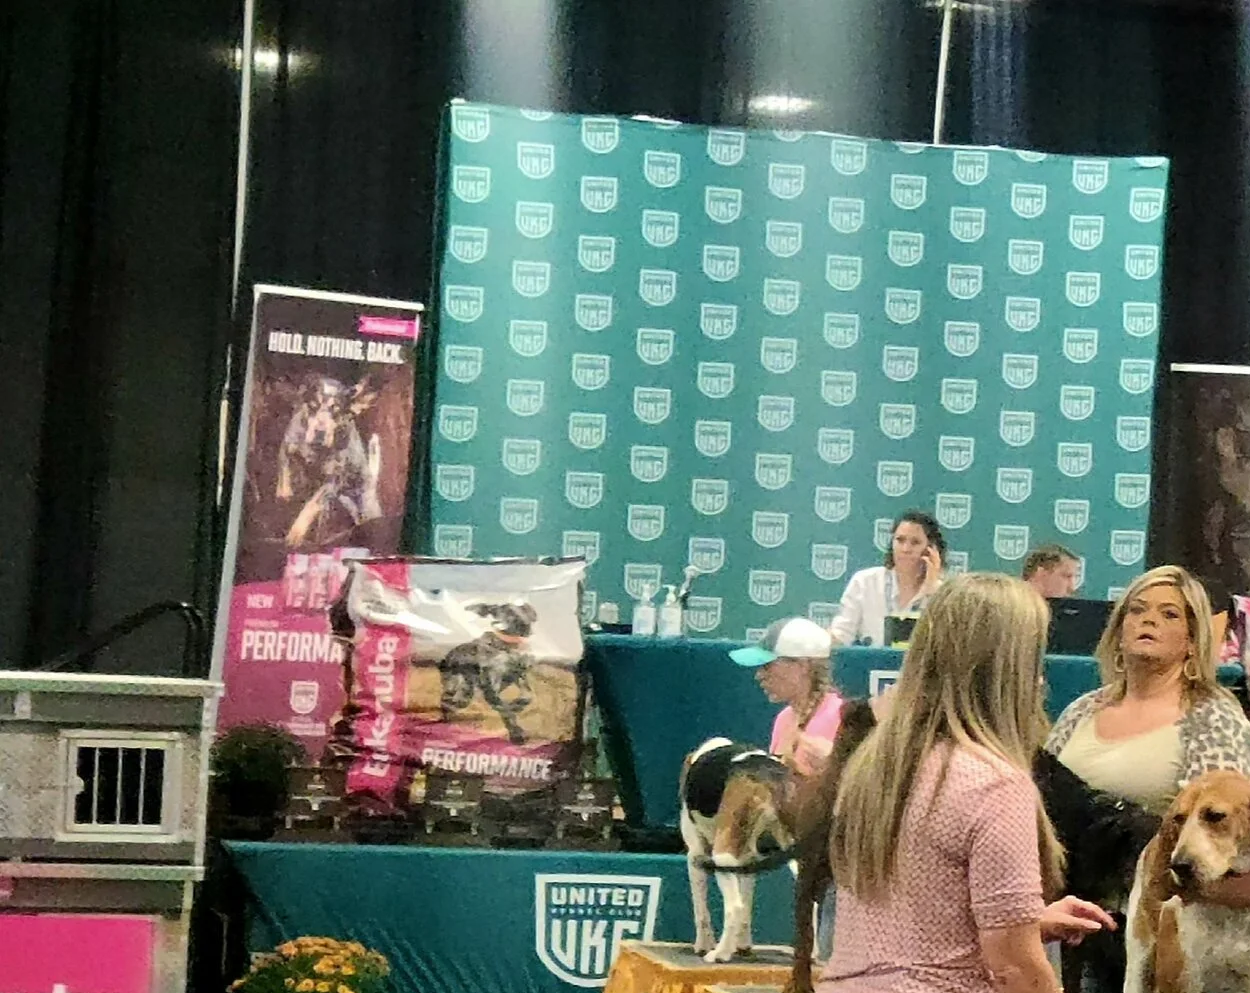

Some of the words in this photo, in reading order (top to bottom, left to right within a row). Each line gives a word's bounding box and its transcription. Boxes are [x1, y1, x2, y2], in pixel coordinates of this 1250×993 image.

[458, 120, 485, 137] UKC
[587, 131, 615, 149] UKC
[712, 143, 740, 161] UKC
[522, 156, 549, 174] UKC
[836, 153, 863, 171] UKC
[649, 164, 676, 183] UKC
[957, 164, 983, 181] UKC
[1077, 172, 1105, 189] UKC
[458, 179, 486, 198] UKC
[773, 177, 800, 195] UKC
[585, 190, 613, 208] UKC
[895, 187, 922, 205] UKC
[1016, 196, 1042, 214] UKC
[710, 200, 737, 219] UKC
[1134, 201, 1160, 218] UKC
[521, 215, 549, 233] UKC
[833, 211, 859, 229] UKC
[954, 220, 981, 238] UKC
[647, 224, 674, 242] UKC
[1074, 228, 1099, 246] UKC
[455, 240, 483, 258] UKC
[771, 234, 797, 253] UKC
[583, 249, 611, 267] UKC
[892, 244, 919, 262] UKC
[1013, 253, 1039, 270] UKC
[708, 259, 735, 277] UKC
[1129, 258, 1154, 275] UKC
[517, 274, 545, 293] UKC
[831, 268, 857, 286] UKC
[952, 277, 978, 295] UKC
[644, 283, 672, 301] UKC
[768, 292, 796, 310] UKC
[1070, 285, 1096, 302] UKC
[450, 299, 478, 318] UKC
[580, 308, 607, 327] UKC
[890, 302, 917, 320] UKC
[705, 317, 732, 335] UKC
[1010, 310, 1036, 327] UKC
[1127, 315, 1152, 332] UKC
[514, 334, 542, 352] UKC
[828, 326, 855, 344] UKC
[949, 335, 975, 352] UKC
[306, 335, 364, 359] NOTHING.
[642, 342, 670, 360] UKC
[1068, 342, 1093, 359] UKC
[450, 359, 478, 378] UKC
[766, 351, 792, 369] UKC
[887, 359, 914, 377] UKC
[577, 367, 605, 385] UKC
[1007, 367, 1033, 384] UKC
[1124, 372, 1149, 389] UKC
[702, 376, 730, 394] UKC
[826, 384, 852, 402] UKC
[512, 393, 539, 411] UKC
[946, 392, 973, 409] UKC
[1065, 398, 1090, 416] UKC
[639, 401, 666, 419] UKC
[762, 409, 790, 427] UKC
[444, 419, 472, 438] UKC
[574, 426, 601, 444] UKC
[884, 417, 911, 435] UKC
[1004, 424, 1030, 442] UKC
[700, 434, 726, 452] UKC
[1121, 430, 1146, 447] UKC
[822, 442, 849, 460] UKC
[943, 449, 970, 467] UKC
[507, 452, 535, 470] UKC
[635, 459, 663, 477] UKC
[1062, 456, 1087, 473] UKC
[760, 467, 788, 485] UKC
[882, 474, 908, 492] UKC
[441, 478, 469, 497] UKC
[570, 485, 598, 503] UKC
[1001, 481, 1028, 498] UKC
[1119, 487, 1144, 504] UKC
[696, 493, 723, 510] UKC
[820, 500, 847, 518] UKC
[505, 511, 533, 529] UKC
[940, 507, 967, 524] UKC
[1059, 512, 1085, 530] UKC
[632, 518, 660, 536] UKC
[757, 525, 784, 543] UKC
[999, 538, 1025, 555] UKC
[1115, 544, 1140, 561] UKC
[816, 558, 843, 576] UKC
[246, 594, 275, 608] NEW
[754, 583, 781, 601] UKC
[421, 747, 553, 780] PERFORMANCE
[551, 886, 645, 907] UNITED
[551, 919, 640, 975] UKC
